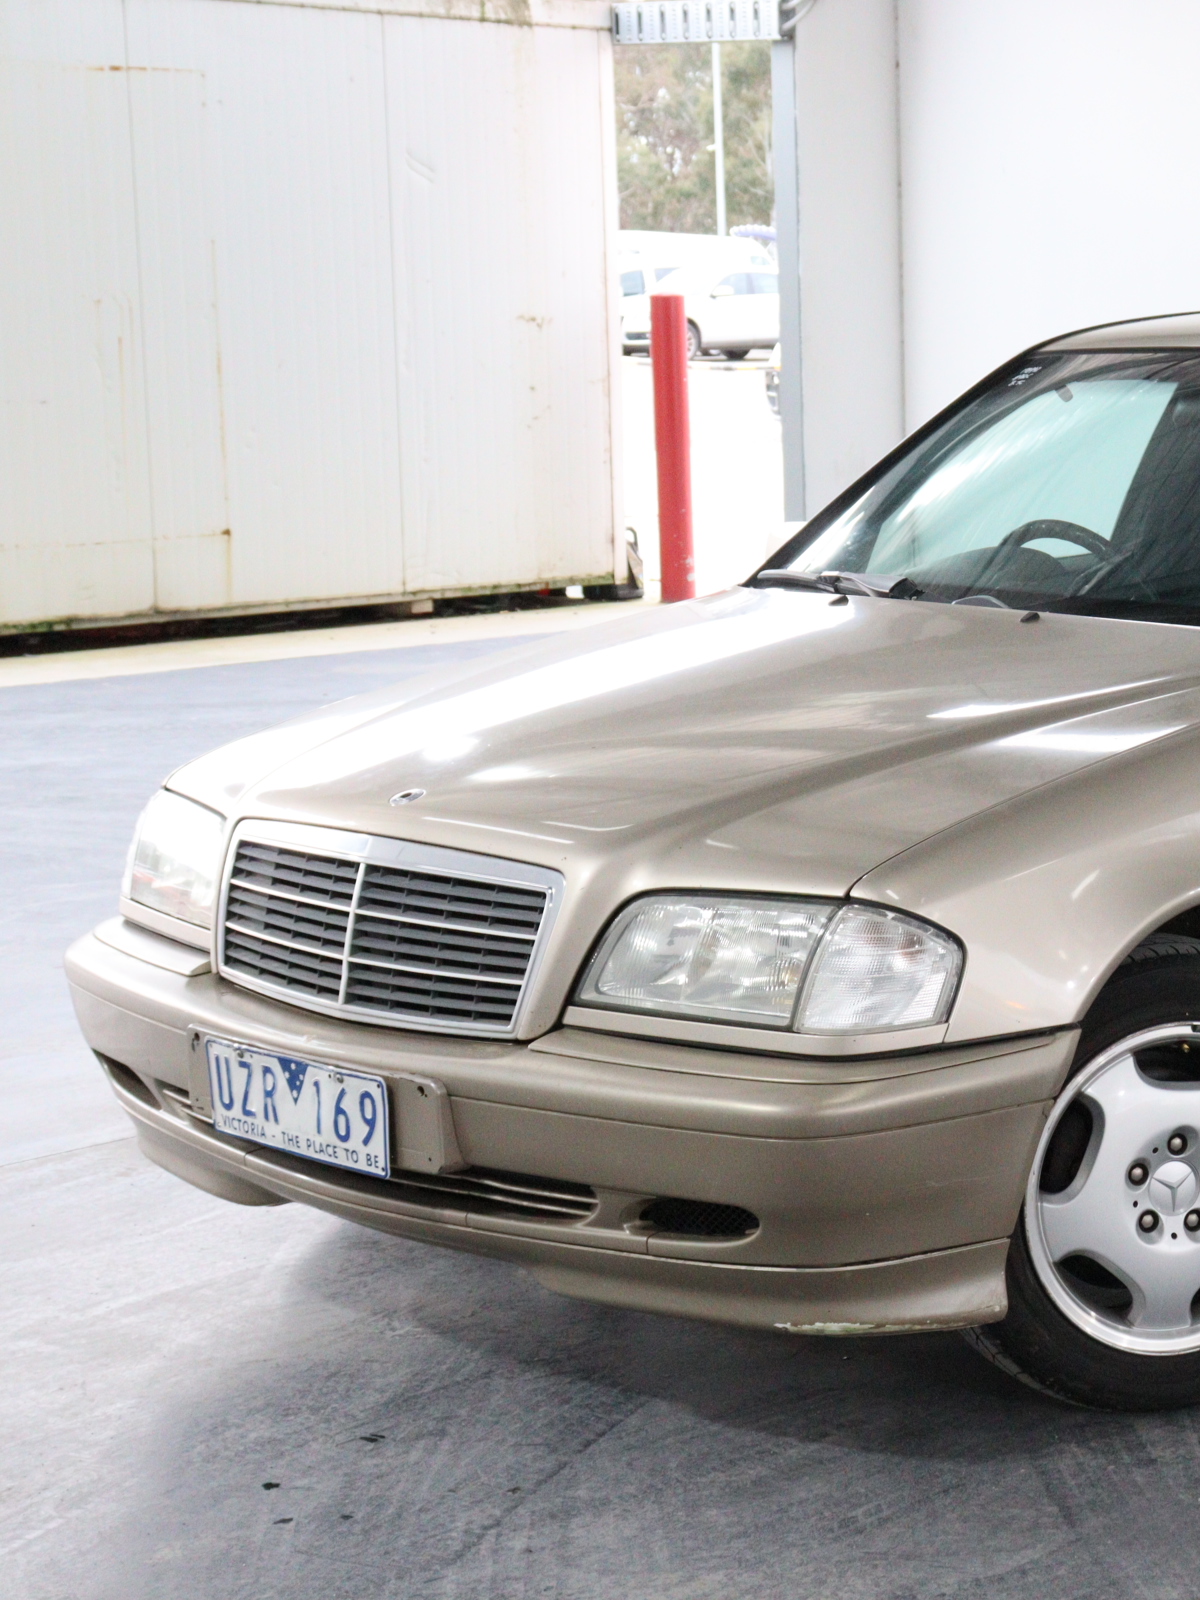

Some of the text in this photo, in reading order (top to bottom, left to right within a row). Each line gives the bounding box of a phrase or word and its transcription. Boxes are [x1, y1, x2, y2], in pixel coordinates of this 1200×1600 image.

[214, 1053, 377, 1147] UZR 169
[221, 1113, 266, 1139] VICTORIA
[281, 1131, 300, 1149] THE
[306, 1138, 339, 1159] PLACE
[343, 1148, 359, 1164] TO
[366, 1154, 380, 1169] BE
